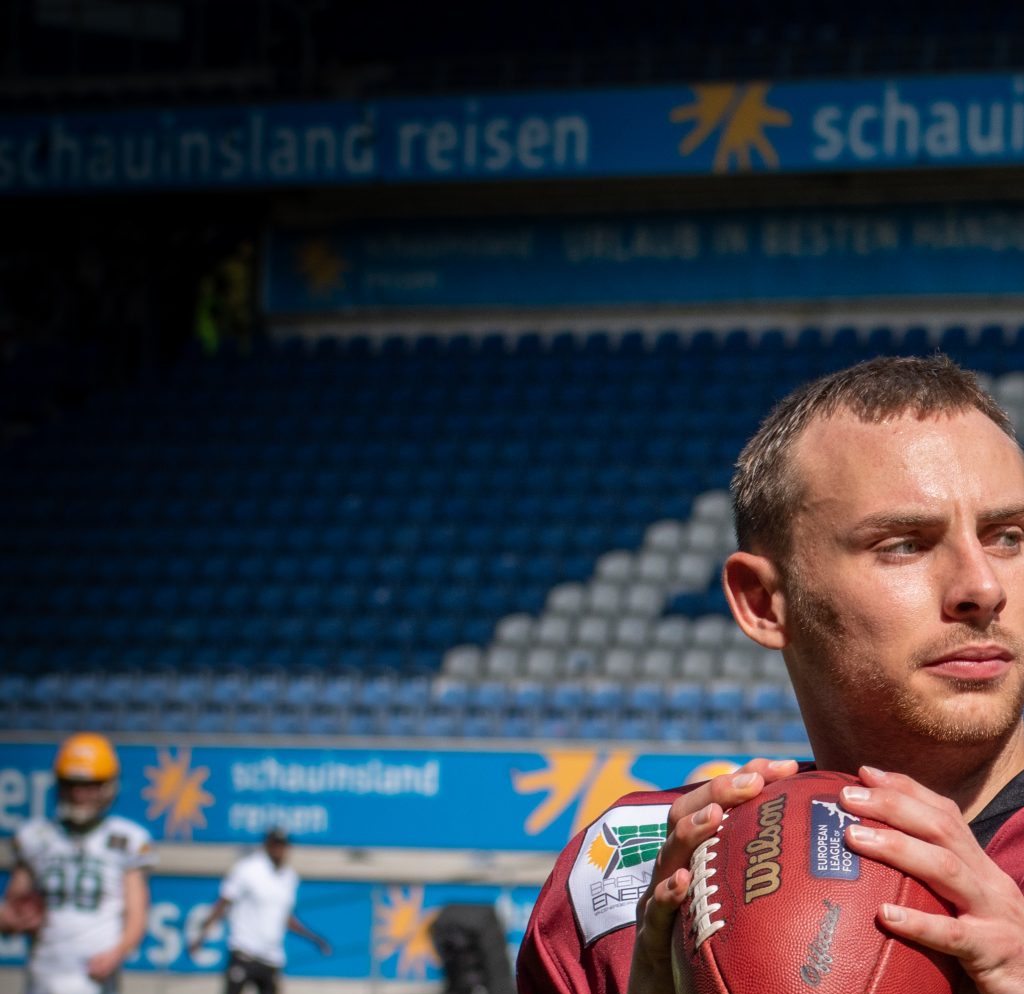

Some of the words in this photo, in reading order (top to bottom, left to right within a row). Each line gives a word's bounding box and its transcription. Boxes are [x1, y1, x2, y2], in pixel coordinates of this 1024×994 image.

[397, 96, 591, 173] reisen
[229, 756, 441, 797] schauinsland
[228, 803, 328, 833] reisen
[744, 794, 786, 905] Wilson
[817, 825, 829, 871] EUROPEAN
[829, 837, 841, 871] LEAGUE
[591, 871, 652, 896] BRENN
